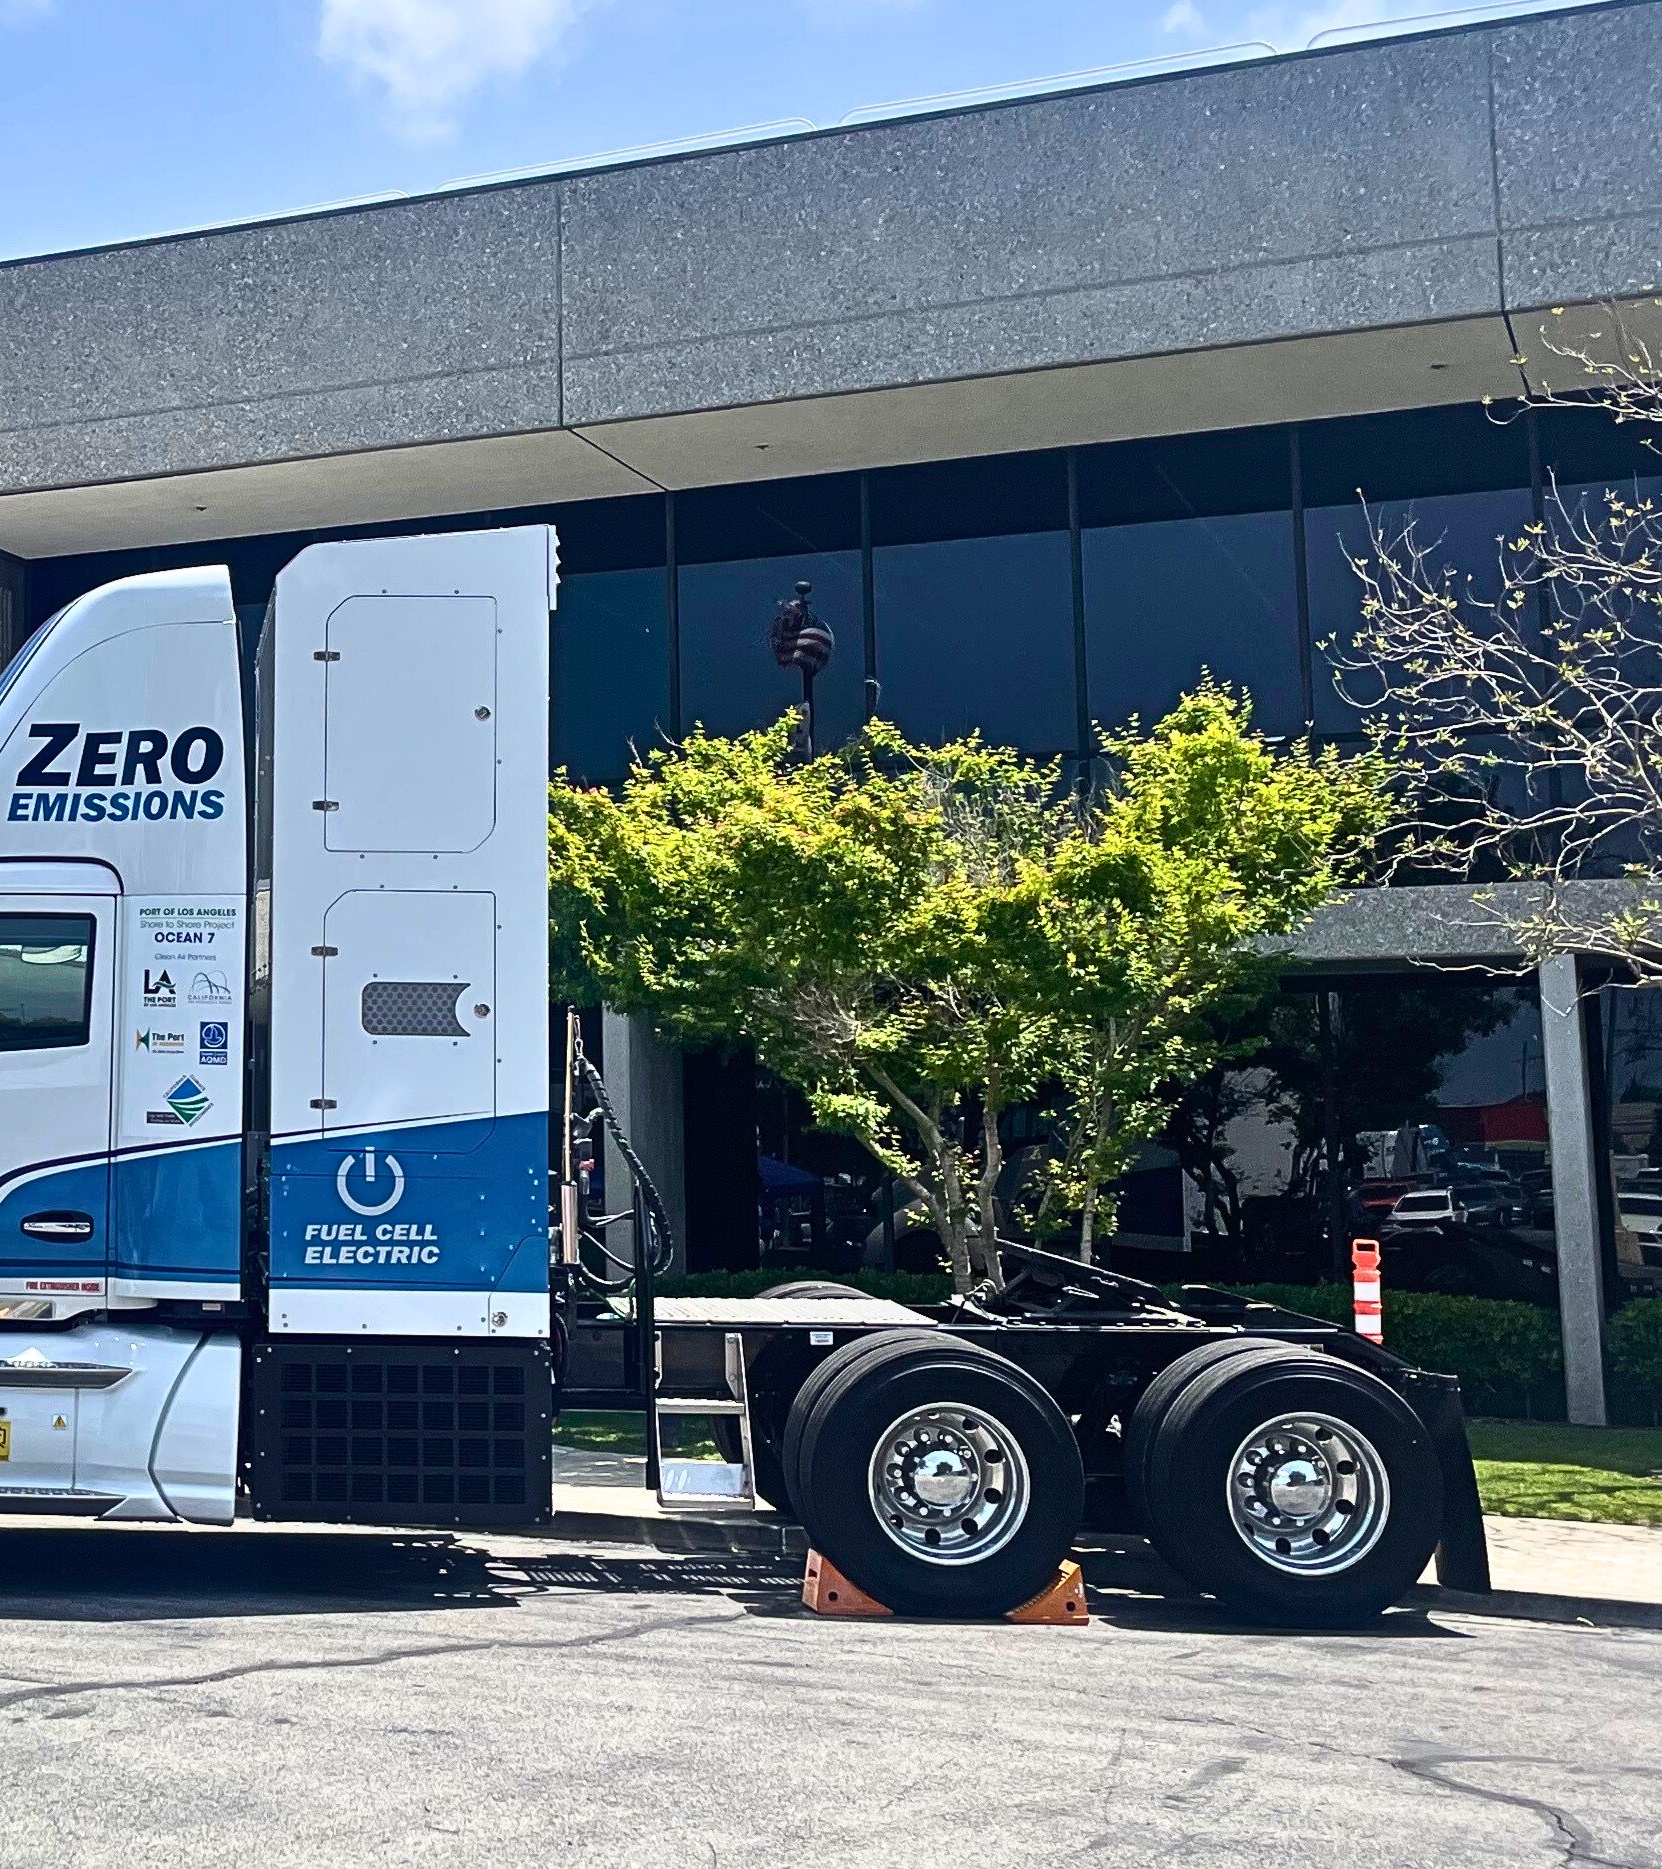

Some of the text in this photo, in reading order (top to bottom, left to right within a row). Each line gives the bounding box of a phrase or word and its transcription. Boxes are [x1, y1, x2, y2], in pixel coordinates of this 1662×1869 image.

[16, 723, 224, 787] ZERO
[7, 790, 226, 822] EMISSIONS
[139, 908, 237, 917] PORT OF LOS ANGELES
[166, 920, 175, 929] to
[204, 920, 236, 931] Project
[154, 931, 216, 944] OCEAN 7
[304, 1224, 438, 1241] FUEL CELL
[304, 1246, 440, 1265] ELECTRIC
